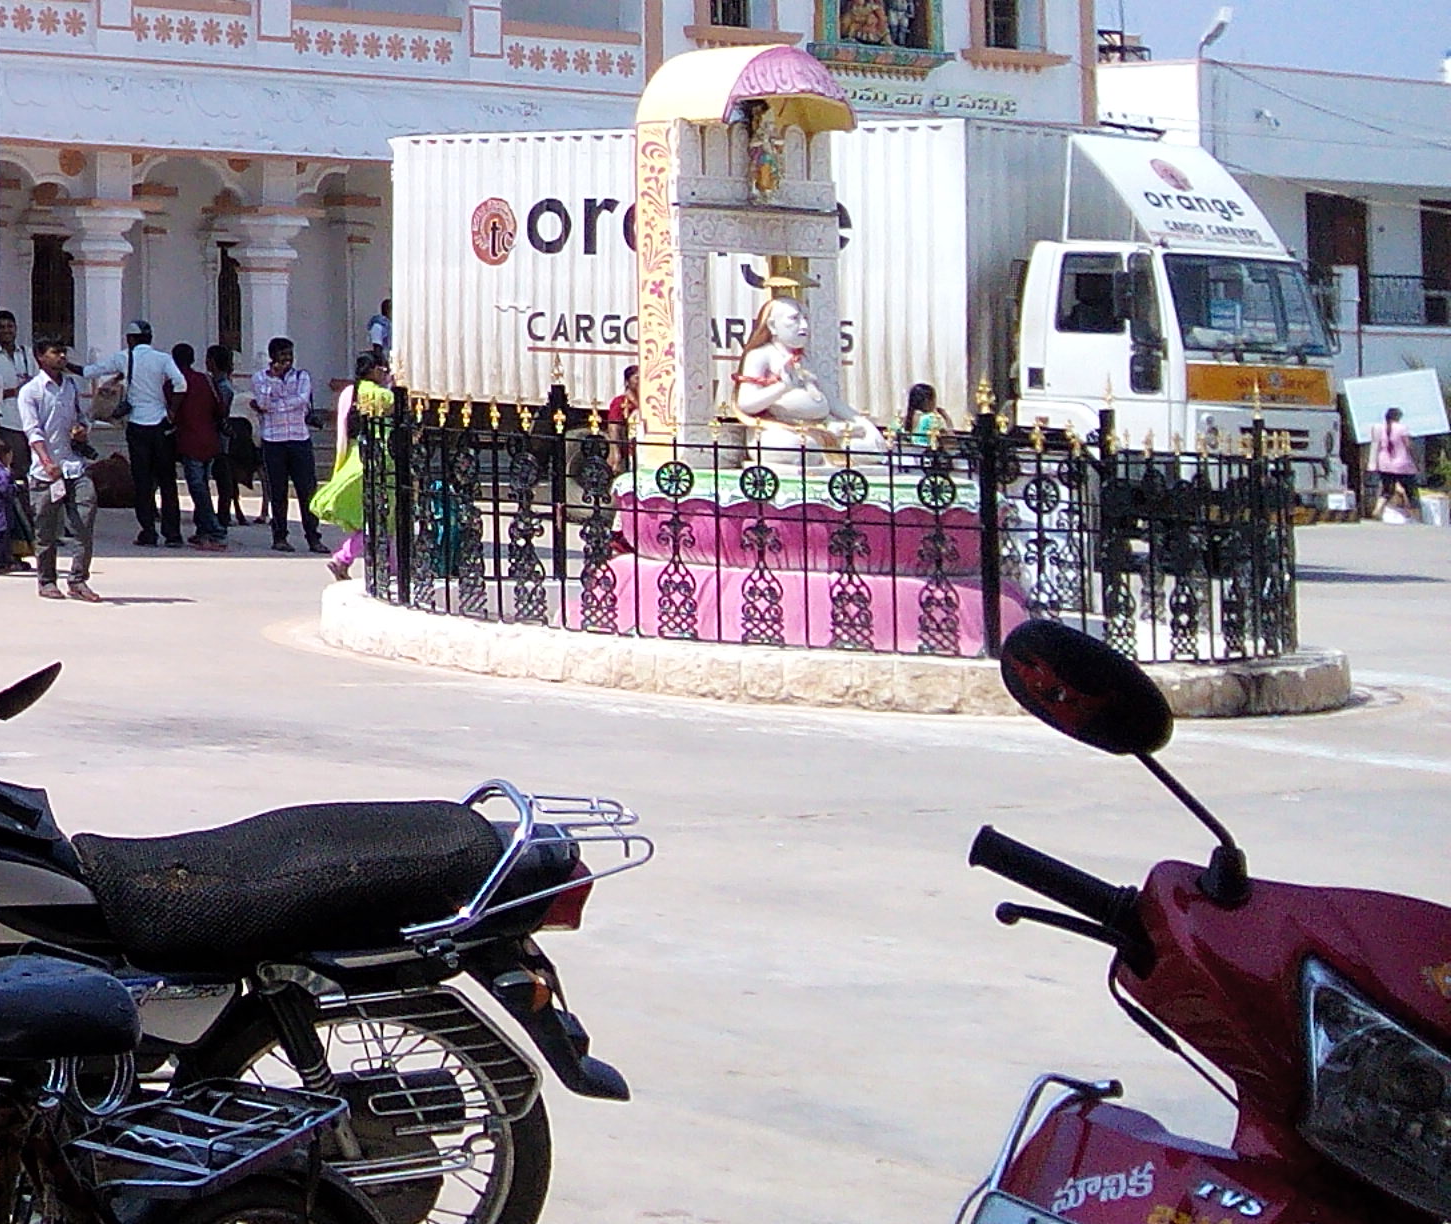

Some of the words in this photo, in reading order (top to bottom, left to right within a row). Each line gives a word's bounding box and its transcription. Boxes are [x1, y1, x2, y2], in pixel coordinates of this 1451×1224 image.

[1143, 191, 1245, 222] orange
[526, 311, 639, 345] CARGO
[1193, 1179, 1269, 1217] TVS
